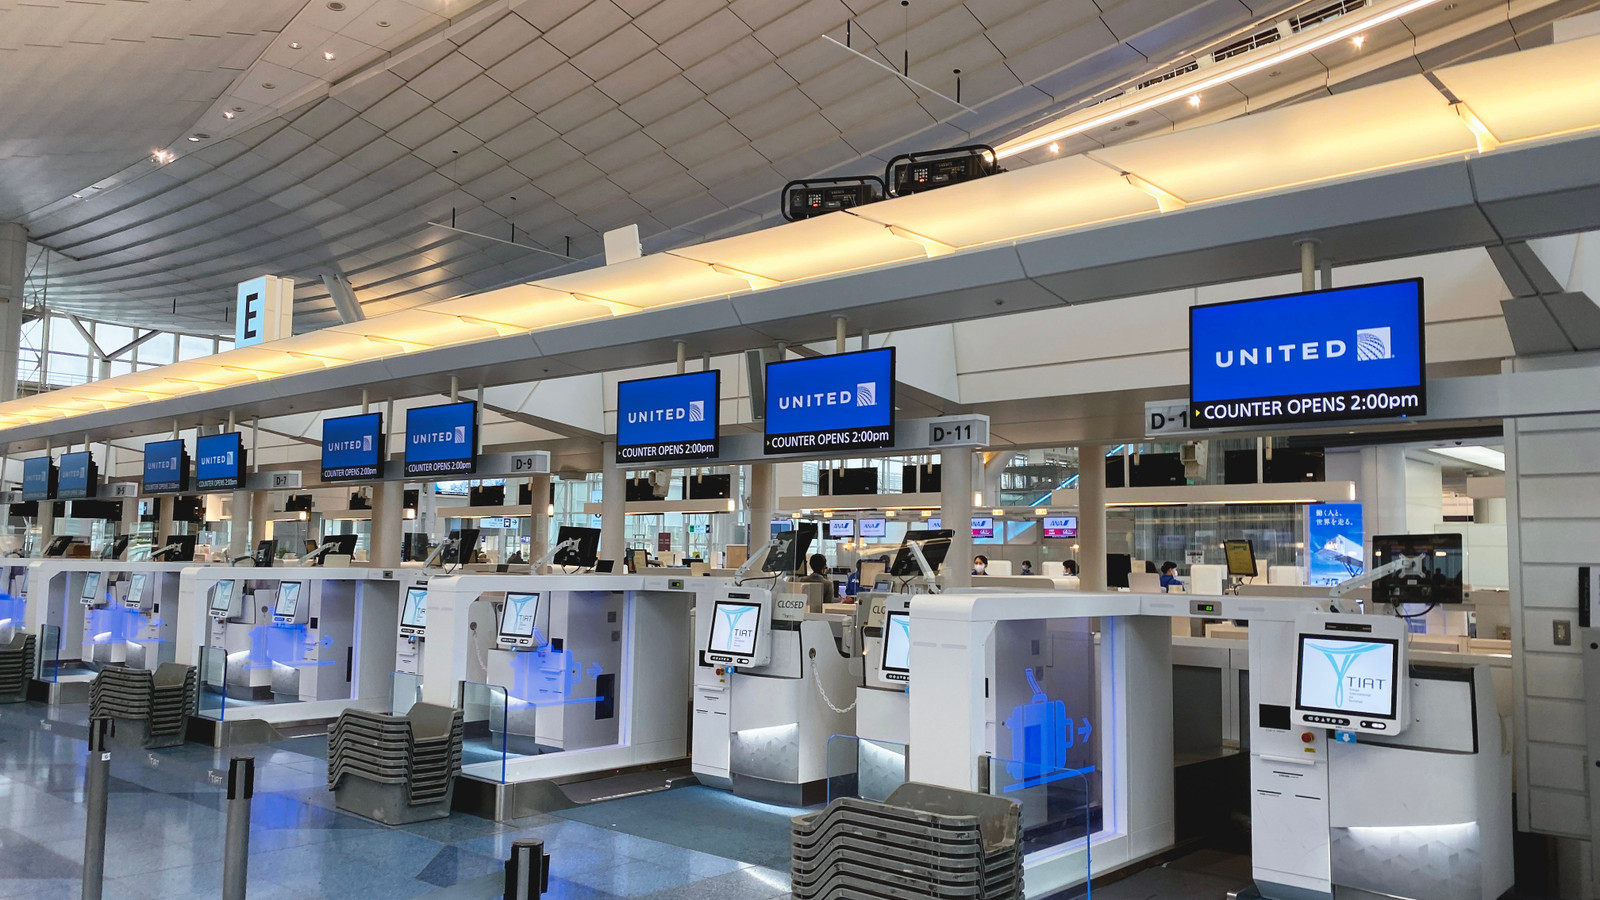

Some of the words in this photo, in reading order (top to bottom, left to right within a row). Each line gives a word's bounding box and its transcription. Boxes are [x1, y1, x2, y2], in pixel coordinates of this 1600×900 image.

[244, 292, 258, 340] E
[1216, 340, 1346, 368] UNITED
[778, 390, 852, 410] UNITED
[1204, 400, 1283, 420] COUNTER
[1287, 396, 1346, 414] OPENS
[1350, 392, 1418, 410] 2:00pm
[628, 408, 686, 424] UNITED
[1152, 410, 1188, 429] D-1
[413, 432, 452, 444] UNITED
[772, 434, 816, 448] COUNTER
[818, 432, 850, 445] OPENS
[852, 430, 889, 444] 2:00pm
[934, 425, 972, 442] D-11
[328, 440, 361, 452] UNITED
[622, 446, 656, 458] COUNTER
[658, 444, 683, 456] OPENS
[685, 443, 714, 454] 2:00pm
[148, 460, 170, 470] UNITED
[201, 455, 226, 465] UNITED
[516, 458, 533, 469] D-9
[324, 469, 344, 478] COUNTER
[345, 468, 360, 477] OPENS
[360, 467, 377, 476] 2:00pm
[408, 463, 433, 473] COUNTER
[433, 462, 451, 471] OPENS
[451, 461, 471, 471] 2:00pm
[276, 476, 287, 485] D-7
[778, 600, 804, 609] CLOSED
[872, 606, 886, 614] CLO
[519, 614, 532, 623] TIAT
[734, 629, 752, 637] TIAT
[1347, 676, 1386, 690] TIAT
